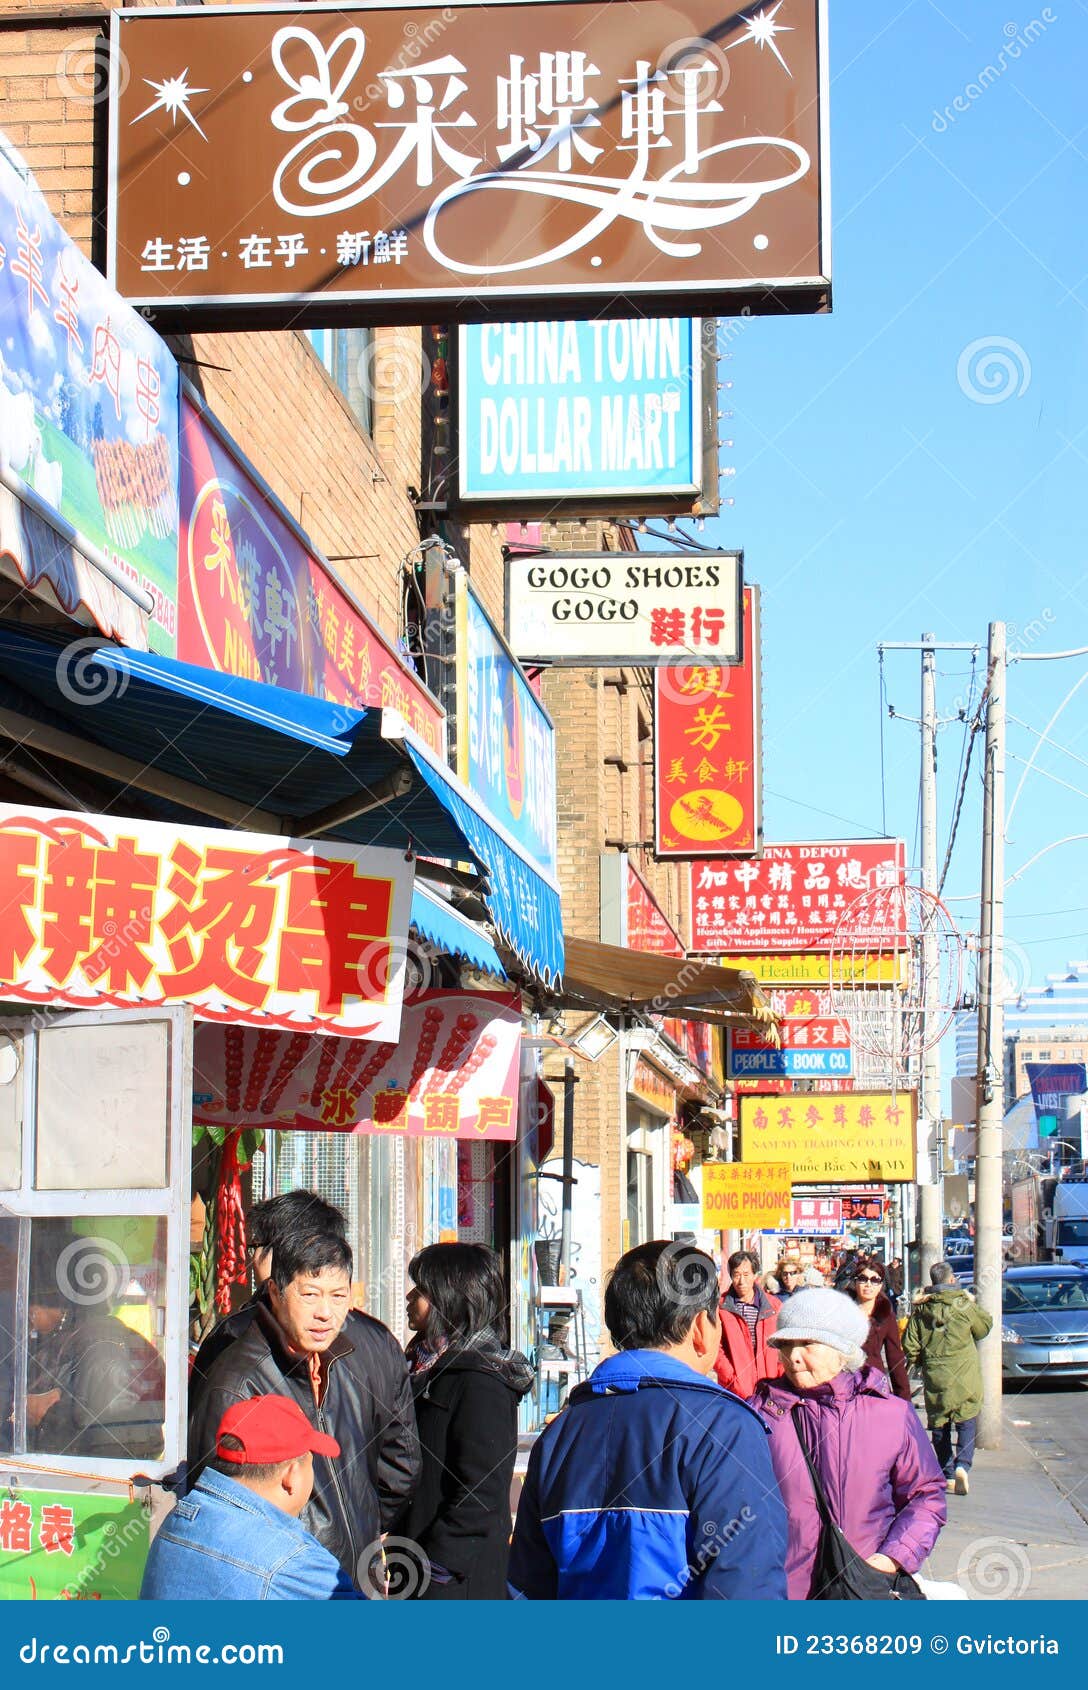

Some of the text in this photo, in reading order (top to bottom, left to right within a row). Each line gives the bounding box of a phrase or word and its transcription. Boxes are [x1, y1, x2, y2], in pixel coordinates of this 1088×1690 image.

[373, 50, 724, 186] 采蝶軒
[480, 317, 681, 385] CHINA TOWN
[480, 391, 681, 475] DOLLAR MART
[527, 565, 720, 588] GOGO SHOES
[552, 598, 639, 620] GOGO
[650, 606, 725, 646] 鞋行
[665, 757, 749, 784] 美食軒
[800, 846, 849, 858] DEPOT
[761, 964, 866, 978] Health Center
[734, 1052, 849, 1070] PEOPLE'S BOOK CO.
[320, 1088, 514, 1132] 冰糖葫芦
